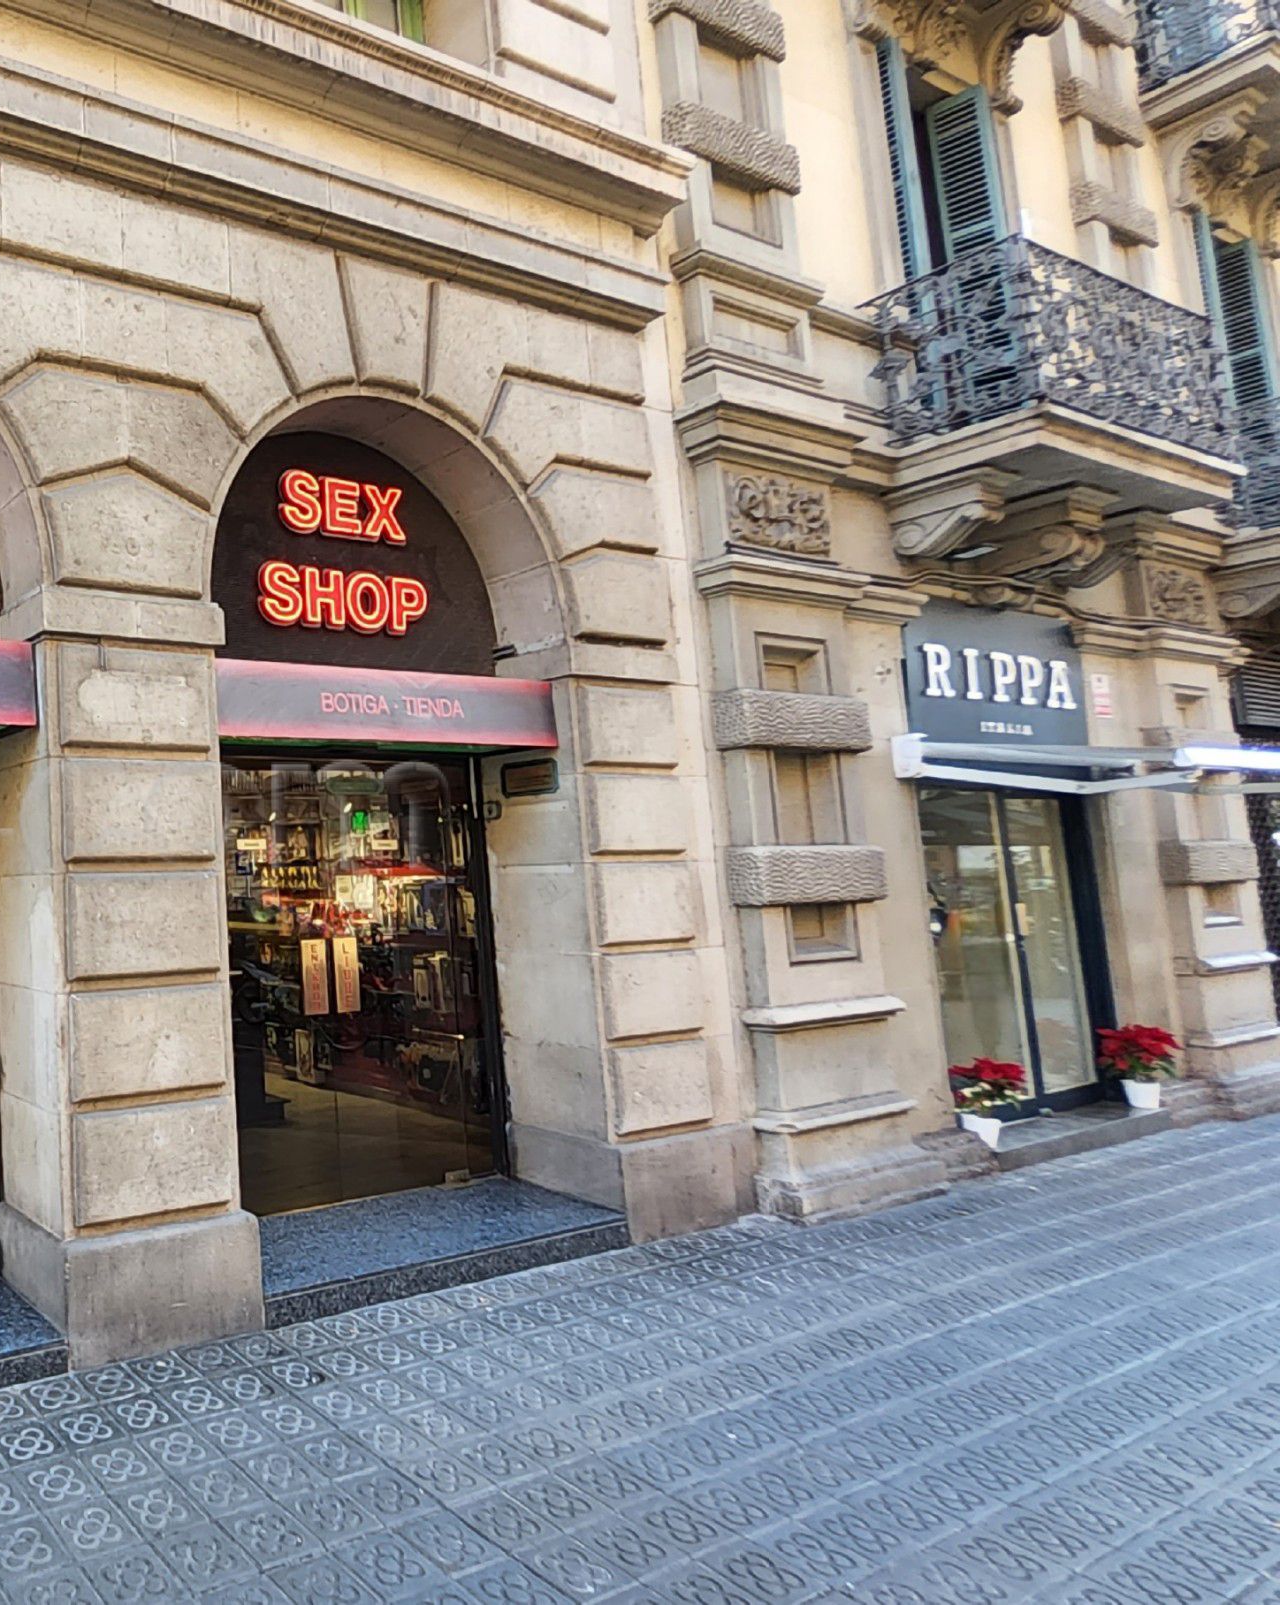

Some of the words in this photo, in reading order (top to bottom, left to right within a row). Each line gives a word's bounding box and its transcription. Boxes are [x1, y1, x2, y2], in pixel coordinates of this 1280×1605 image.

[278, 469, 407, 546] SEX
[258, 561, 428, 636] SHOP
[320, 692, 391, 716] BOTIGA
[401, 695, 465, 719] TIENDA
[922, 642, 1078, 710] RIPPA
